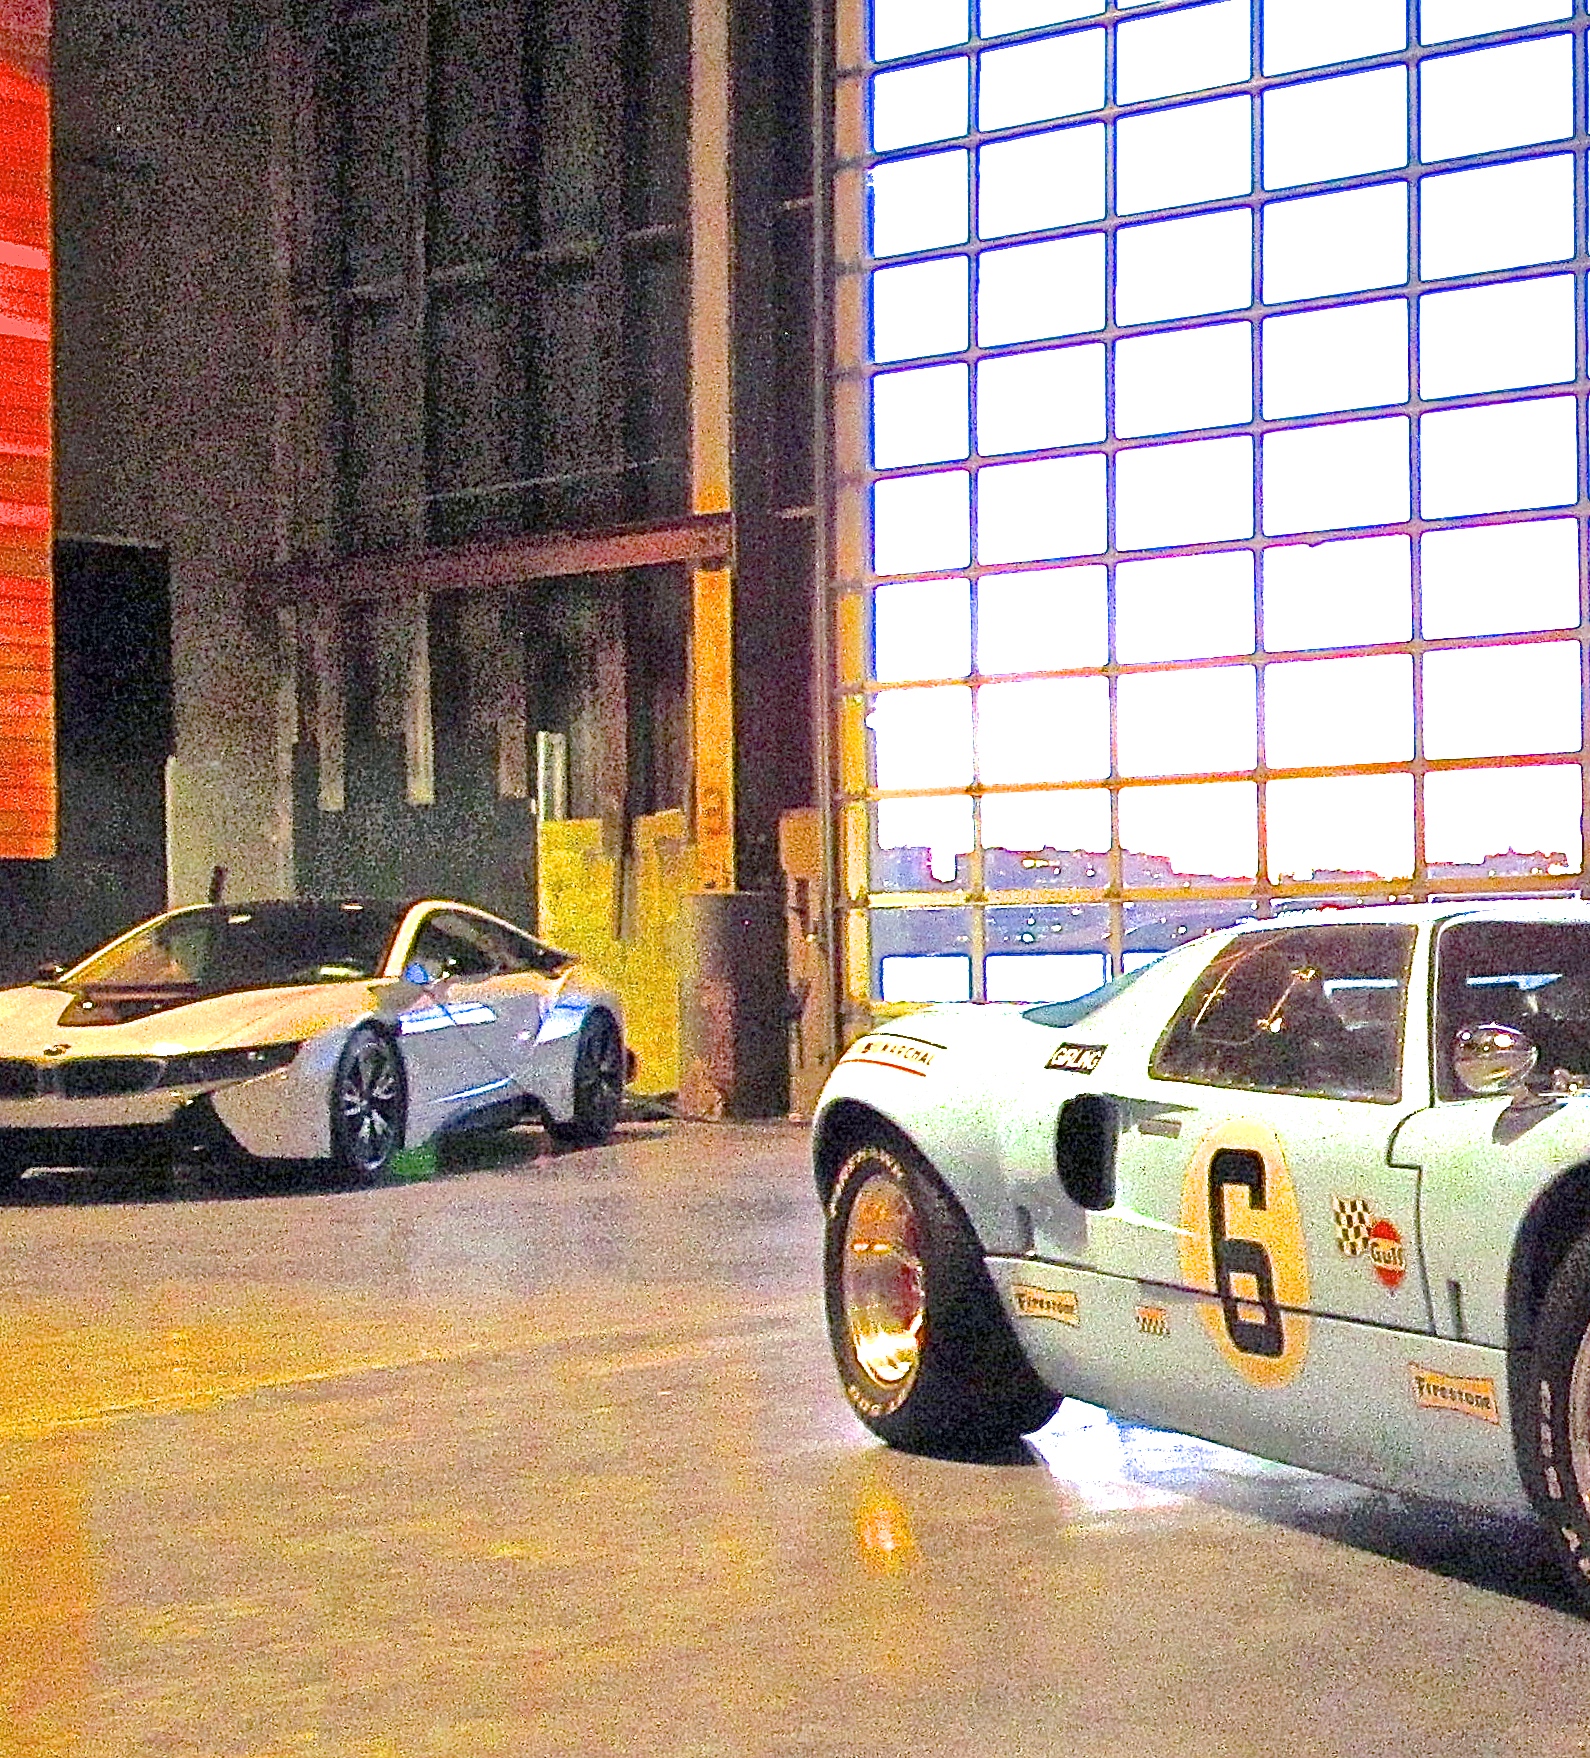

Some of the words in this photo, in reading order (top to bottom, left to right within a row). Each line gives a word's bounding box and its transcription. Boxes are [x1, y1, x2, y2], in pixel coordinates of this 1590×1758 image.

[1207, 1148, 1285, 1358] 6
[1371, 1242, 1405, 1267] Gulf
[1414, 1375, 1492, 1411] Firestone
